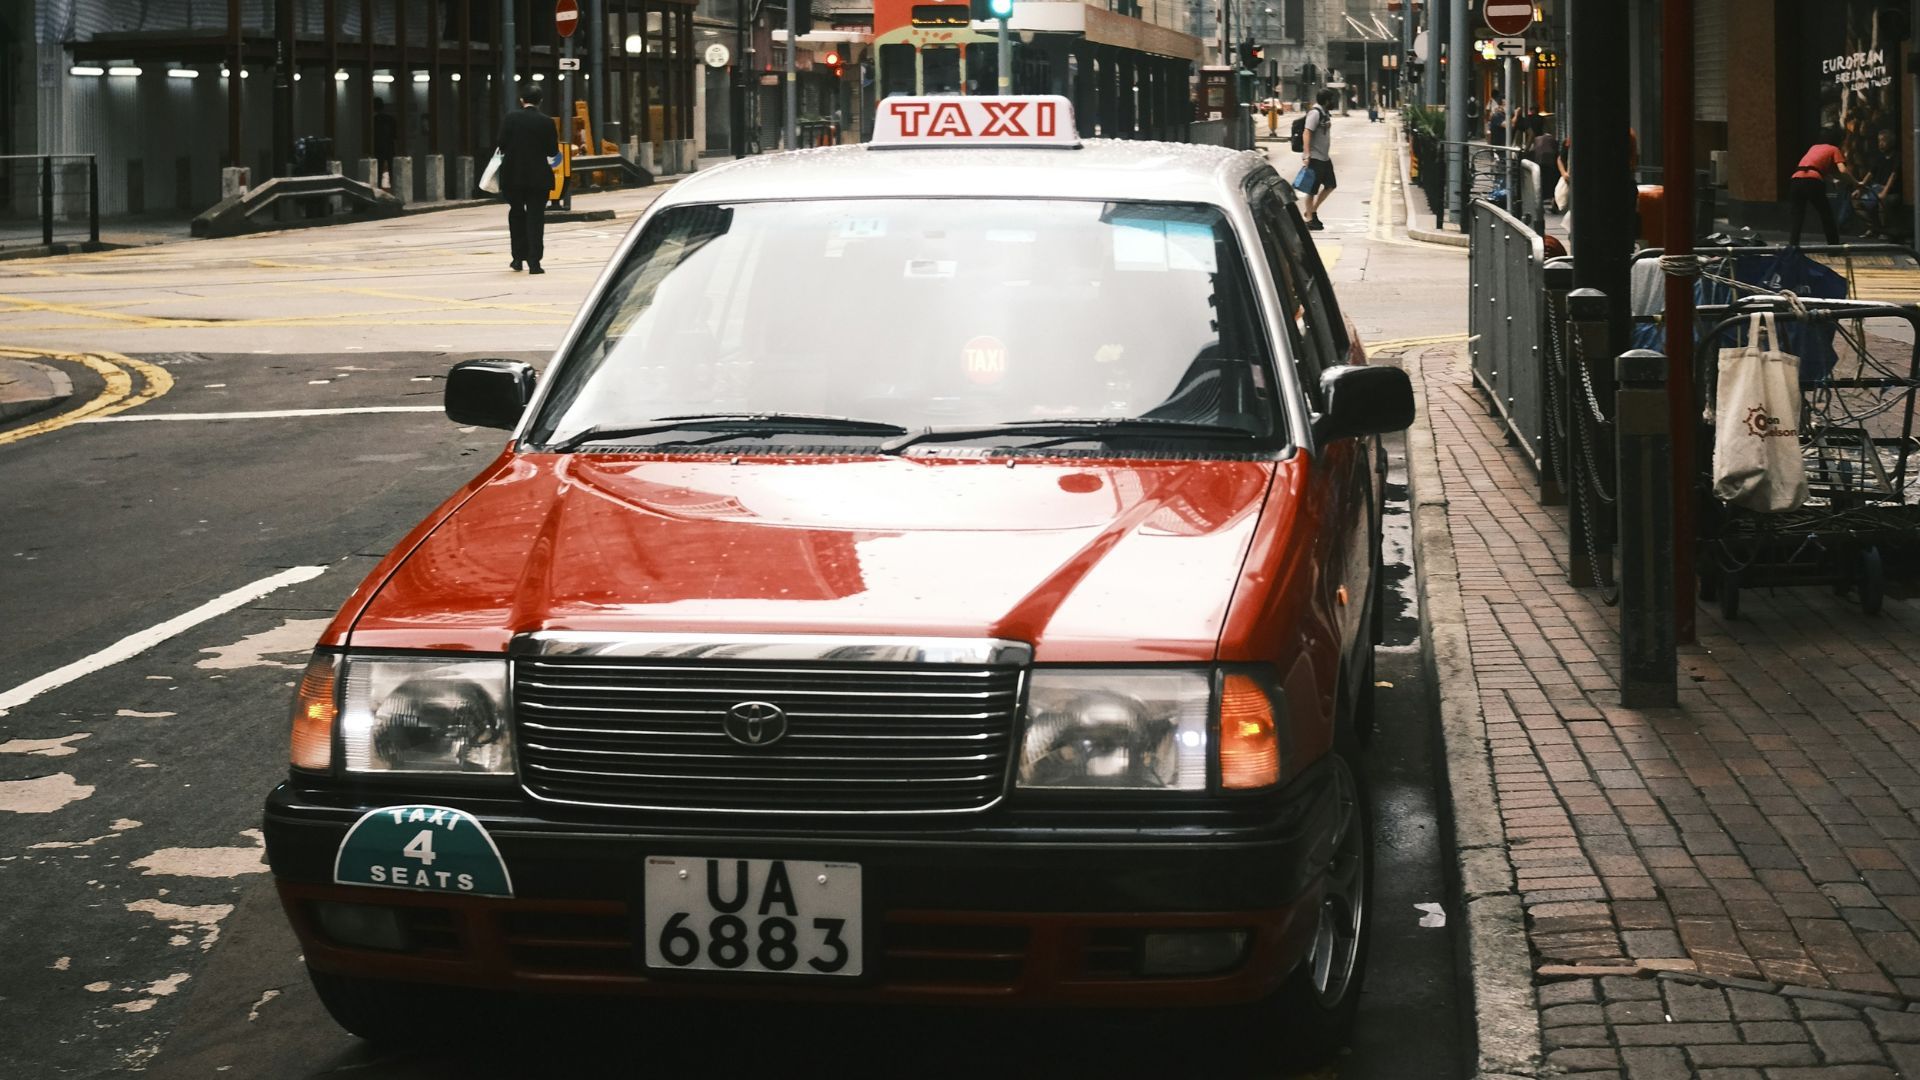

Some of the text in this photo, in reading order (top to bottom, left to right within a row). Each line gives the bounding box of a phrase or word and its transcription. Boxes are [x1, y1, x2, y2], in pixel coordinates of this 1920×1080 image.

[1822, 49, 1884, 74] EUROPEAN
[890, 102, 1056, 137] TAXI
[965, 349, 1005, 371] TAXI
[389, 808, 461, 831] TAXI
[403, 829, 436, 865] 4
[370, 865, 474, 891] SEATS
[706, 859, 799, 917] UA
[659, 912, 849, 973] 6883
